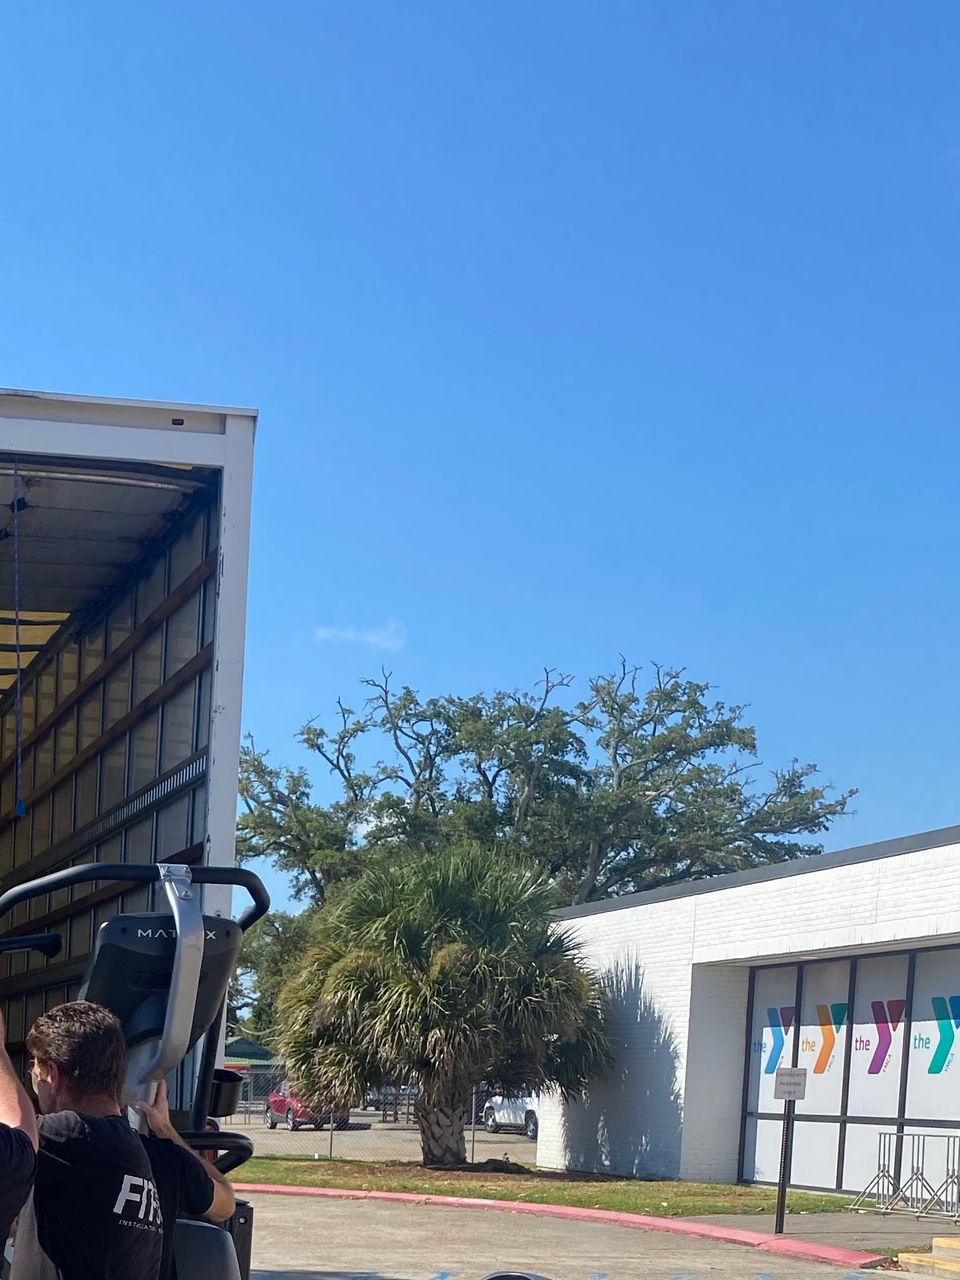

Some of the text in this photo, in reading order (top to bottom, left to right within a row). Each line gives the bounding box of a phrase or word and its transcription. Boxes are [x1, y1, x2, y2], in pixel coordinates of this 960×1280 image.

[137, 928, 216, 940] MATX
[801, 1037, 816, 1052] the
[855, 1035, 871, 1051] the
[913, 1033, 931, 1050] the
